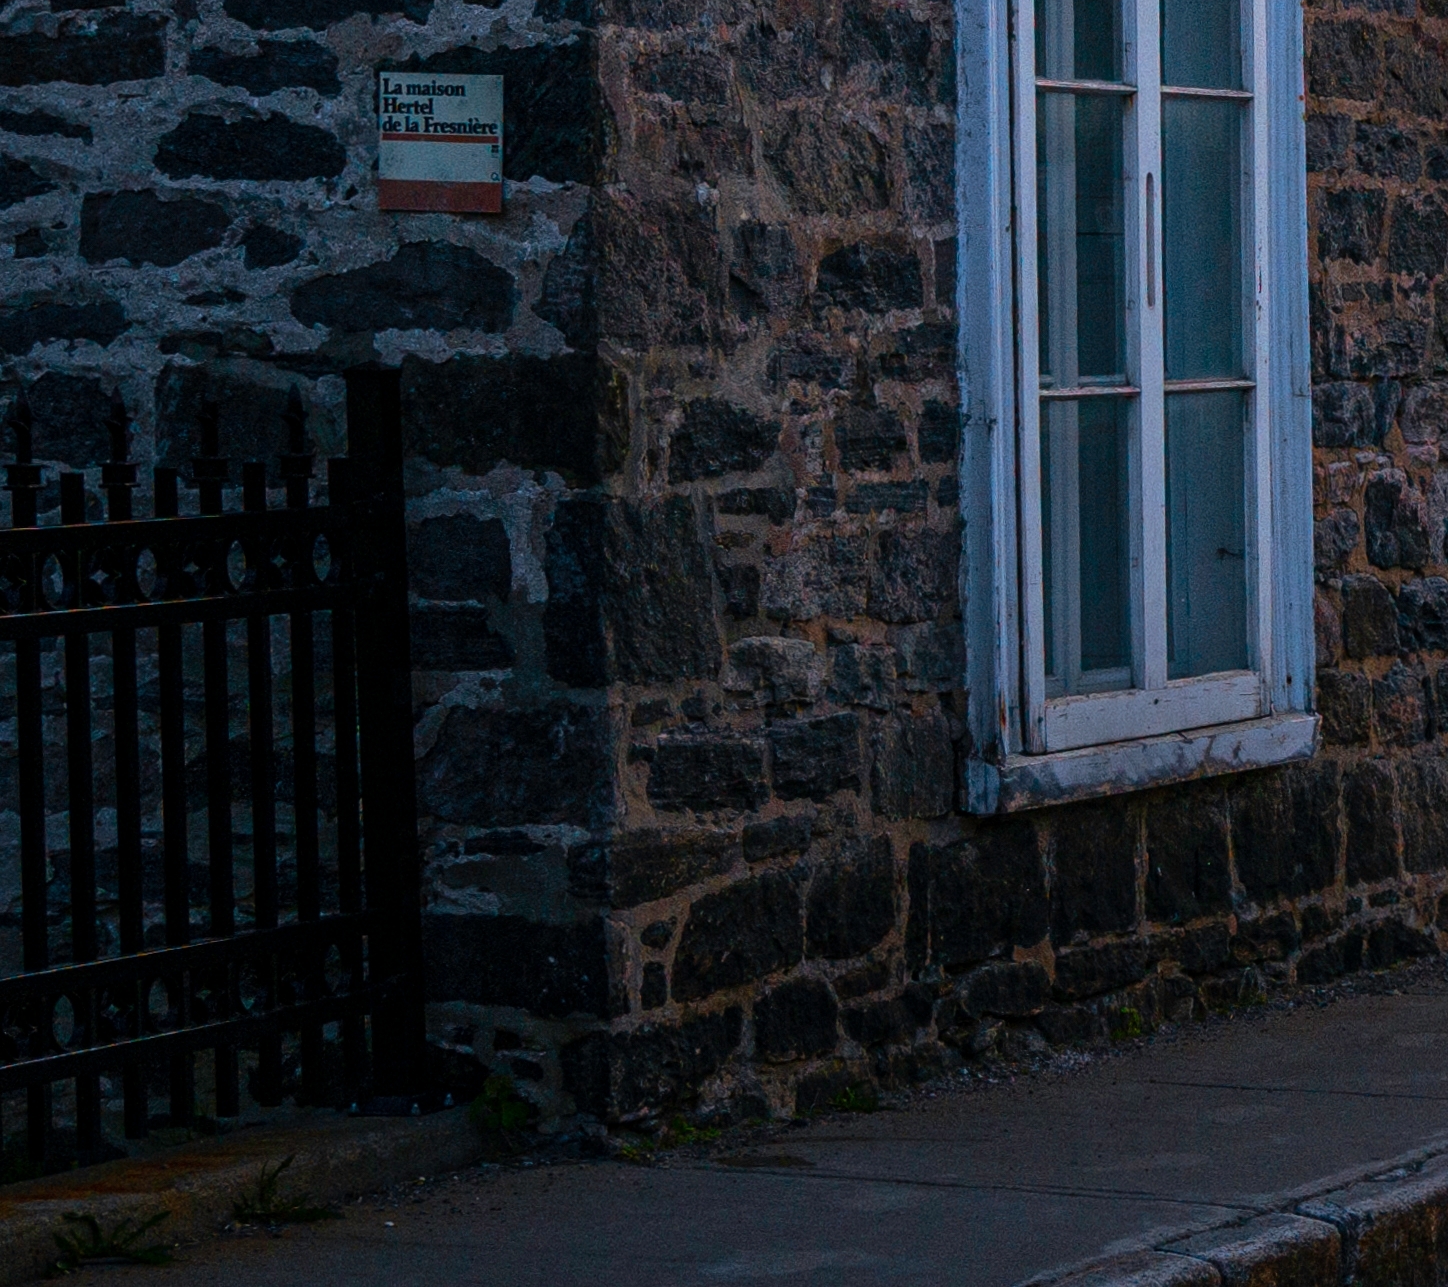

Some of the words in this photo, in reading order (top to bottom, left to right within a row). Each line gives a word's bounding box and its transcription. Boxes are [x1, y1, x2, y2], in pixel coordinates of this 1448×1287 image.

[382, 78, 402, 95] La
[406, 80, 466, 96] maison
[382, 97, 434, 115] Hertel
[382, 116, 402, 132] de
[405, 116, 419, 132] la
[424, 116, 498, 135] Fresnière
